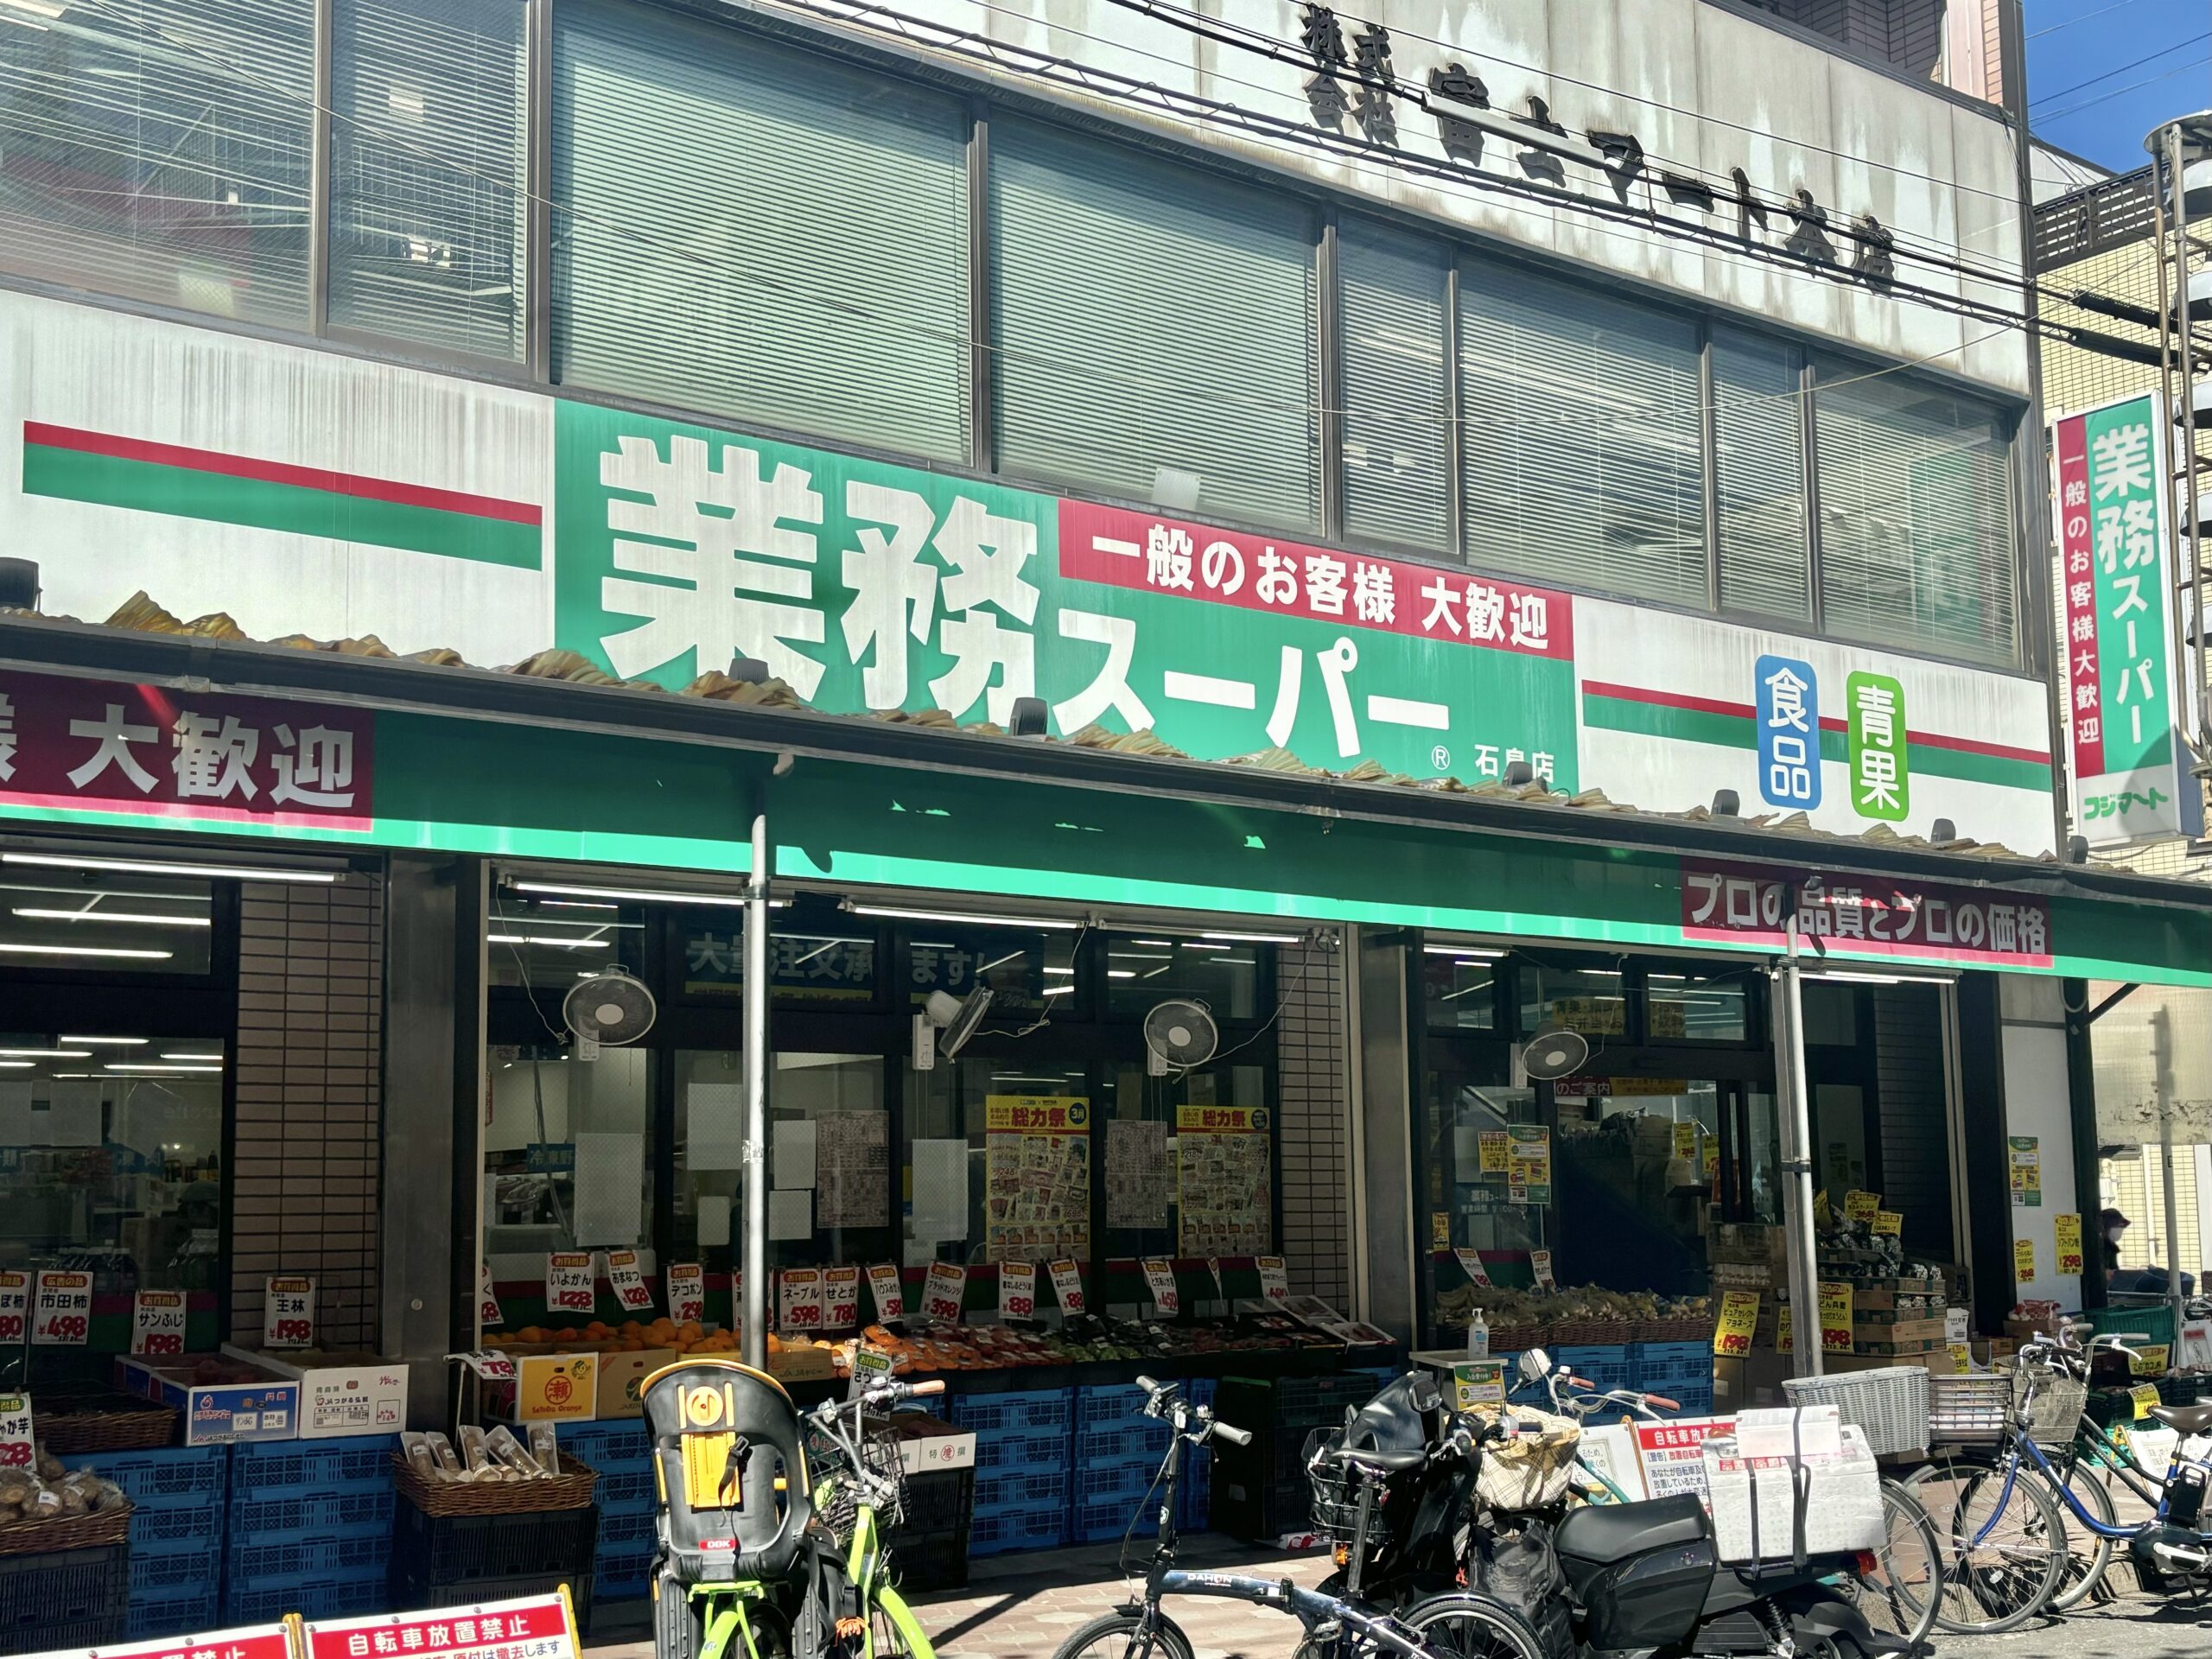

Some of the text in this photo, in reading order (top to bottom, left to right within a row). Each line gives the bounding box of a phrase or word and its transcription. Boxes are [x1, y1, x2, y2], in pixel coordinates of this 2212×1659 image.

[1092, 522, 1549, 650] 一般のお客様 大歓迎
[2093, 423, 2155, 745] 業務スーパー
[600, 435, 1449, 758] 業務スーパー
[2063, 454, 2100, 746] 一般のお客様大歓迎
[1764, 667, 1812, 800] 食品
[67, 703, 355, 808] 大歓迎
[1856, 684, 1900, 810] 青果
[1687, 873, 2046, 955] プロの品質とプロの価格
[1012, 1107, 1065, 1127] 総力祭
[1203, 1109, 1245, 1127] 総力祭
[45, 1276, 85, 1287] 広告の品
[550, 1273, 592, 1286] いよかん
[613, 1271, 640, 1283] あまなつ
[41, 1294, 87, 1308] 市田柿
[784, 1287, 820, 1300] ネーブル
[826, 1286, 857, 1300] せとか
[277, 1299, 305, 1313] 王林
[784, 1306, 820, 1324] ¥598
[826, 1305, 856, 1323] ¥780
[1723, 1307, 1755, 1318] ピュアセレクト
[38, 1316, 86, 1338] ¥498
[139, 1313, 183, 1328] サンふじ
[270, 1319, 311, 1340] ¥198
[1726, 1318, 1753, 1329] マヨネーズ
[136, 1334, 182, 1354] ¥198
[1717, 1334, 1750, 1351] ¥198
[1187, 1573, 1232, 1585] DAHON
[348, 1614, 531, 1656] 自転車放置禁止
